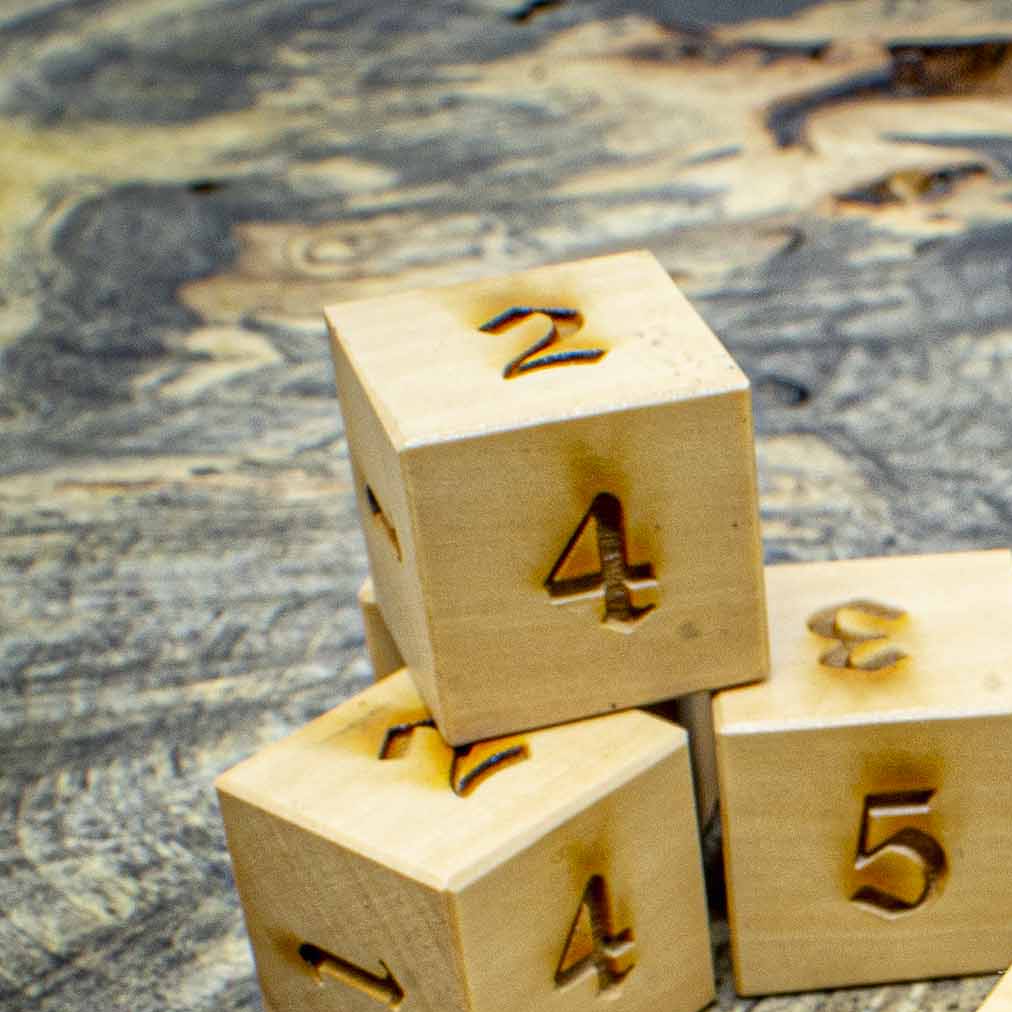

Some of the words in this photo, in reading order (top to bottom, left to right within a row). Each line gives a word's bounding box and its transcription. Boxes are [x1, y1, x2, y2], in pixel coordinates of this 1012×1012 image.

[478, 305, 606, 379] 2
[543, 491, 658, 633] 4
[807, 599, 910, 671] 3
[849, 788, 950, 921] 5
[553, 874, 635, 1000] 4
